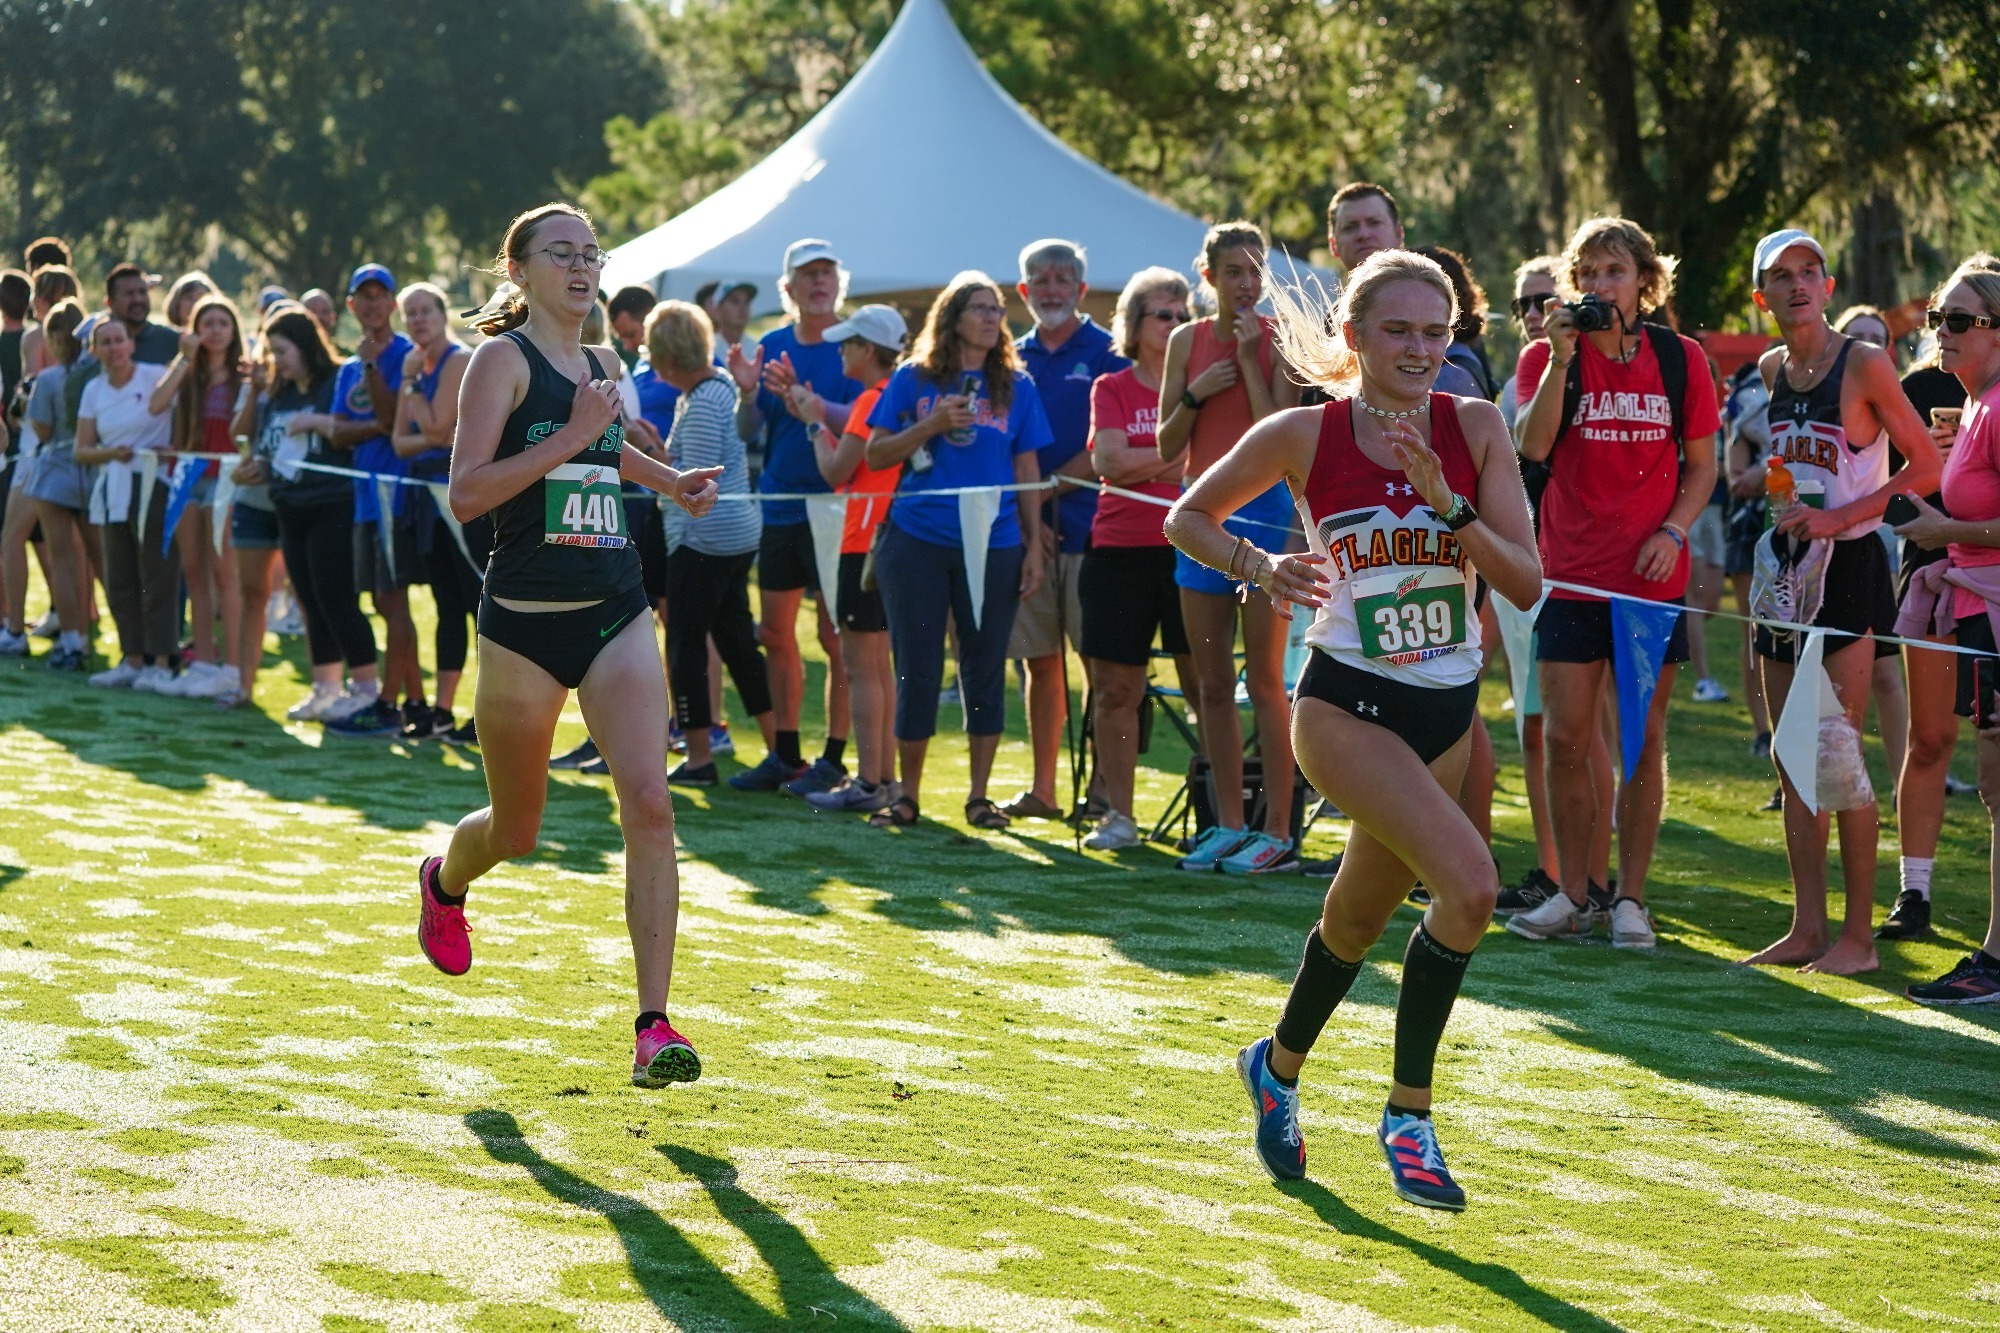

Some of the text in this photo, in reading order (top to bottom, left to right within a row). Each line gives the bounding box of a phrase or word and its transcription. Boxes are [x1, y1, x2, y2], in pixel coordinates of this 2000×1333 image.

[1632, 428, 1667, 442] FIELD
[562, 493, 619, 534] 440
[1374, 600, 1452, 652] 339
